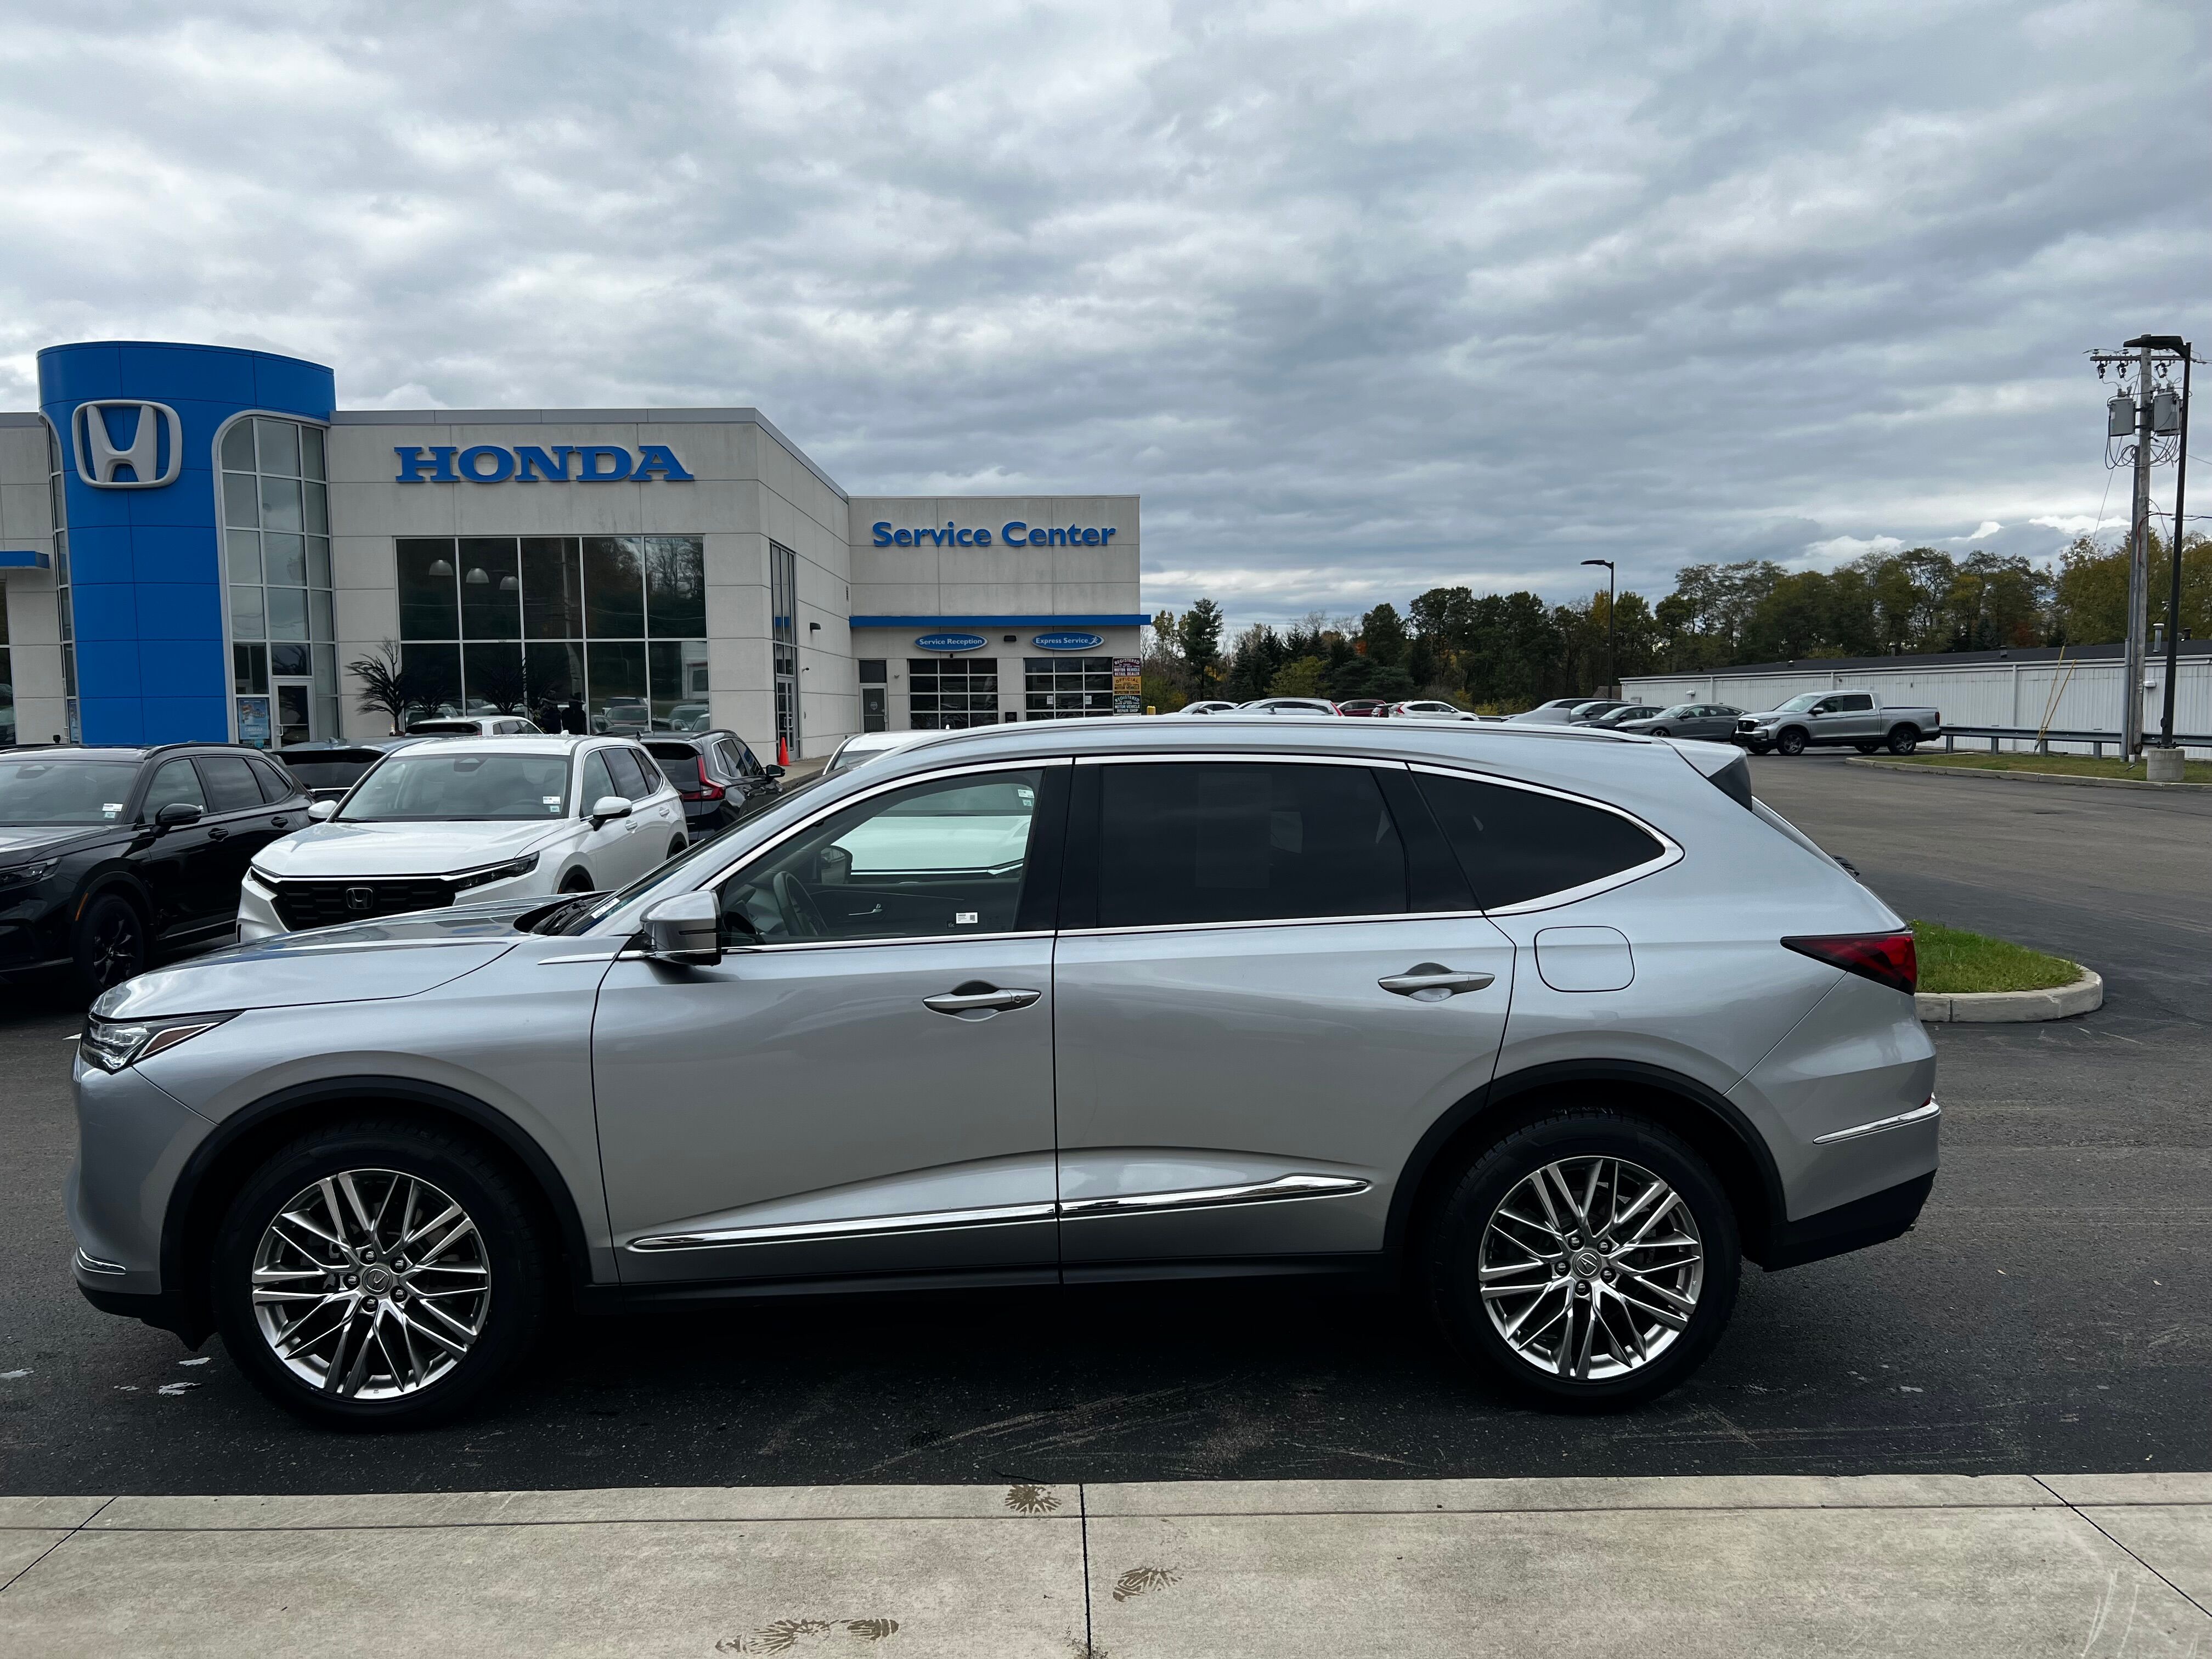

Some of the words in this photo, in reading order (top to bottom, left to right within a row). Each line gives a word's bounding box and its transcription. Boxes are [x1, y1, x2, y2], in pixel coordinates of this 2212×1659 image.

[394, 445, 694, 482] HONDA
[872, 521, 992, 546] Service
[1001, 522, 1117, 546] Center
